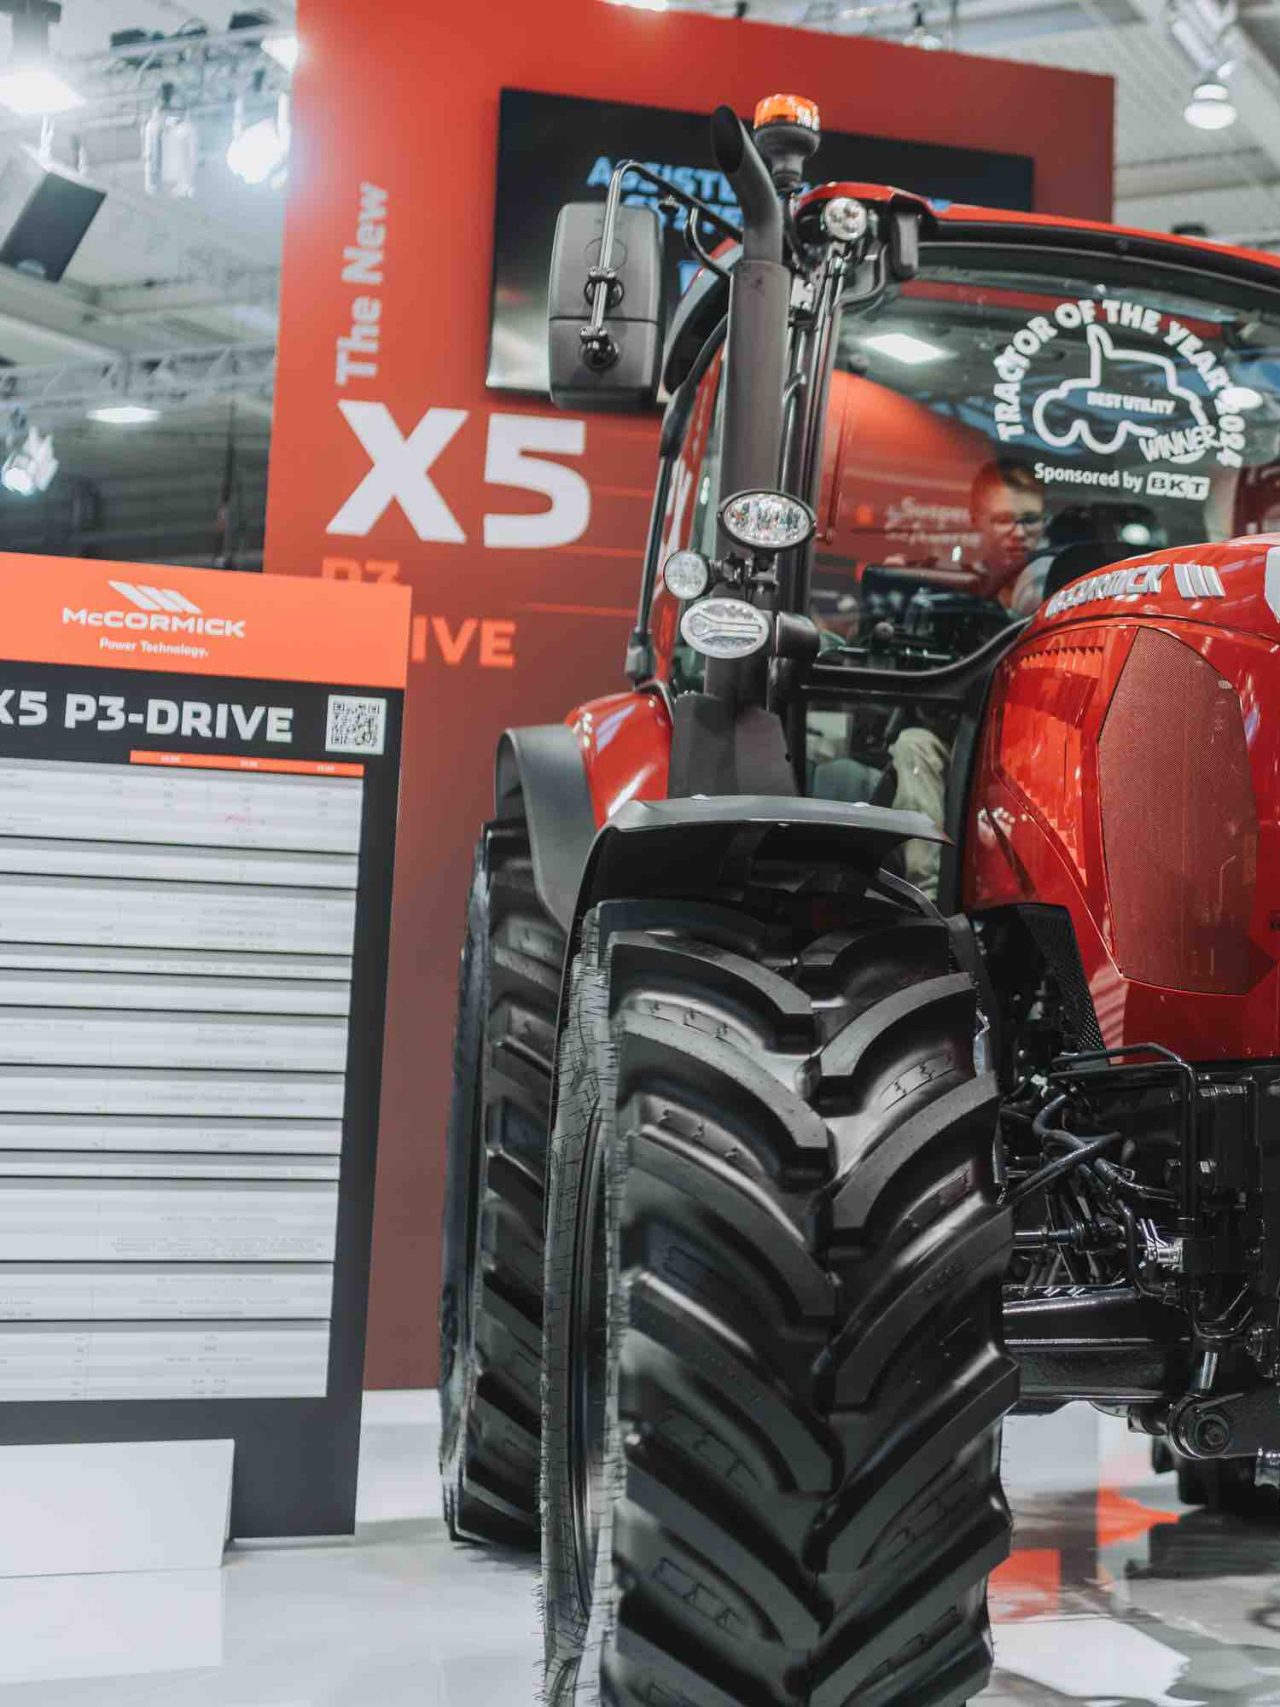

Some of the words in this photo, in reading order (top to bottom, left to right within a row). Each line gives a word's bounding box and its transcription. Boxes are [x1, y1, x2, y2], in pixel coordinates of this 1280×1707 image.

[341, 182, 389, 286] New
[335, 296, 382, 386] The
[993, 316, 1058, 441] TRACTOR
[1054, 300, 1096, 328] OF
[1102, 300, 1162, 334] THE
[1163, 321, 1234, 393] YEAR
[1086, 391, 1122, 408] BEST
[1123, 395, 1176, 415] UTILITY
[1138, 424, 1222, 462] WINNER
[326, 400, 591, 548] X5
[1034, 462, 1120, 487] Sponsored
[1122, 471, 1144, 494] by
[1149, 474, 1208, 498] BKT
[62, 607, 247, 638] McCORMICK
[100, 637, 137, 651] Power
[411, 614, 516, 668] IVE
[64, 693, 294, 743] P3-DRIVE
